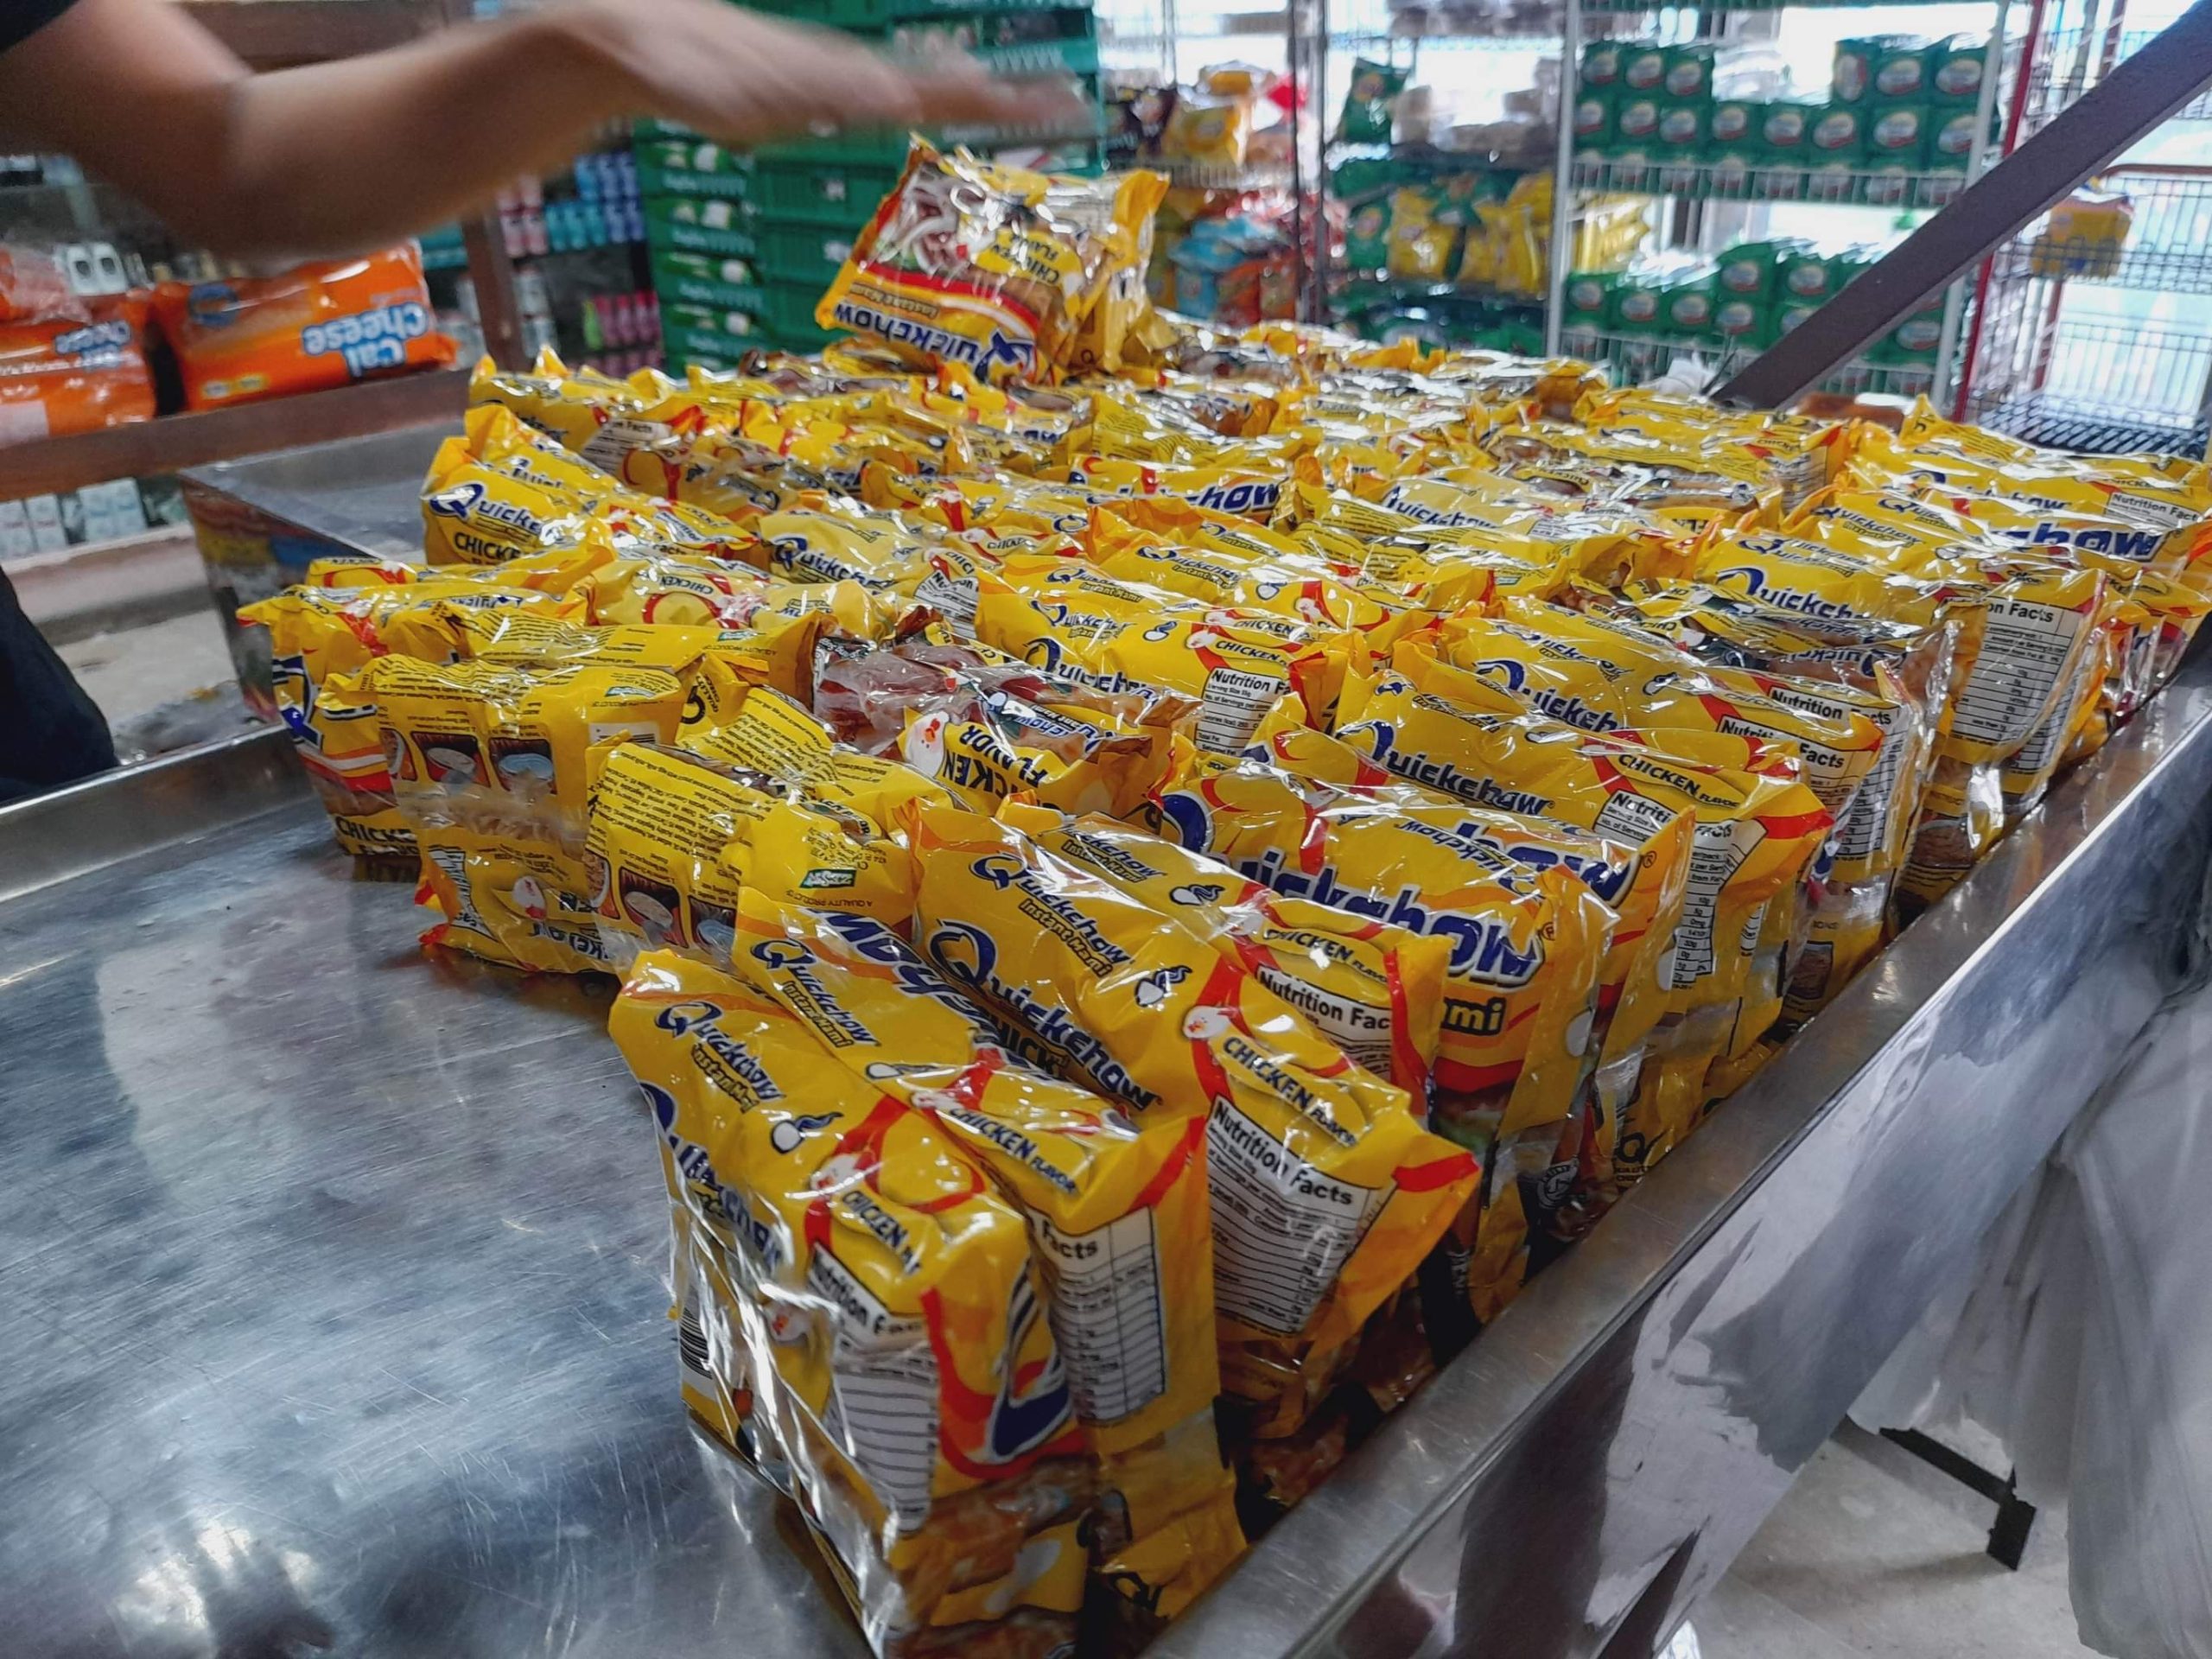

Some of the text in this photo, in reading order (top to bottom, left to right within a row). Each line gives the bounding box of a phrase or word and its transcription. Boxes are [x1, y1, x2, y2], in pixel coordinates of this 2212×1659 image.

[302, 302, 429, 355] Cheese
[346, 339, 407, 378] Cal
[2113, 493, 2200, 522] Nutrition Fact
[454, 531, 523, 563] CHICKE
[2007, 602, 2055, 624] Facts
[1215, 639, 1281, 661] CHICKEN
[1211, 669, 1271, 693] Nutrition
[1771, 690, 1843, 720] Nutrition
[942, 749, 1020, 800] ICKEN
[1799, 742, 1846, 769] Facts
[1618, 753, 1702, 798] CHICKEN
[1611, 792, 1672, 823] Nutriti
[1017, 897, 1115, 980] Instant Mami
[1351, 959, 1389, 983] FLAVO
[928, 917, 1163, 1112] Quickchow
[1258, 969, 1392, 1030] Nutrition Fac
[1440, 996, 1507, 1036] mi
[1222, 1035, 1314, 1111] CHICKEN
[1213, 1100, 1354, 1205] Nutrition Facts
